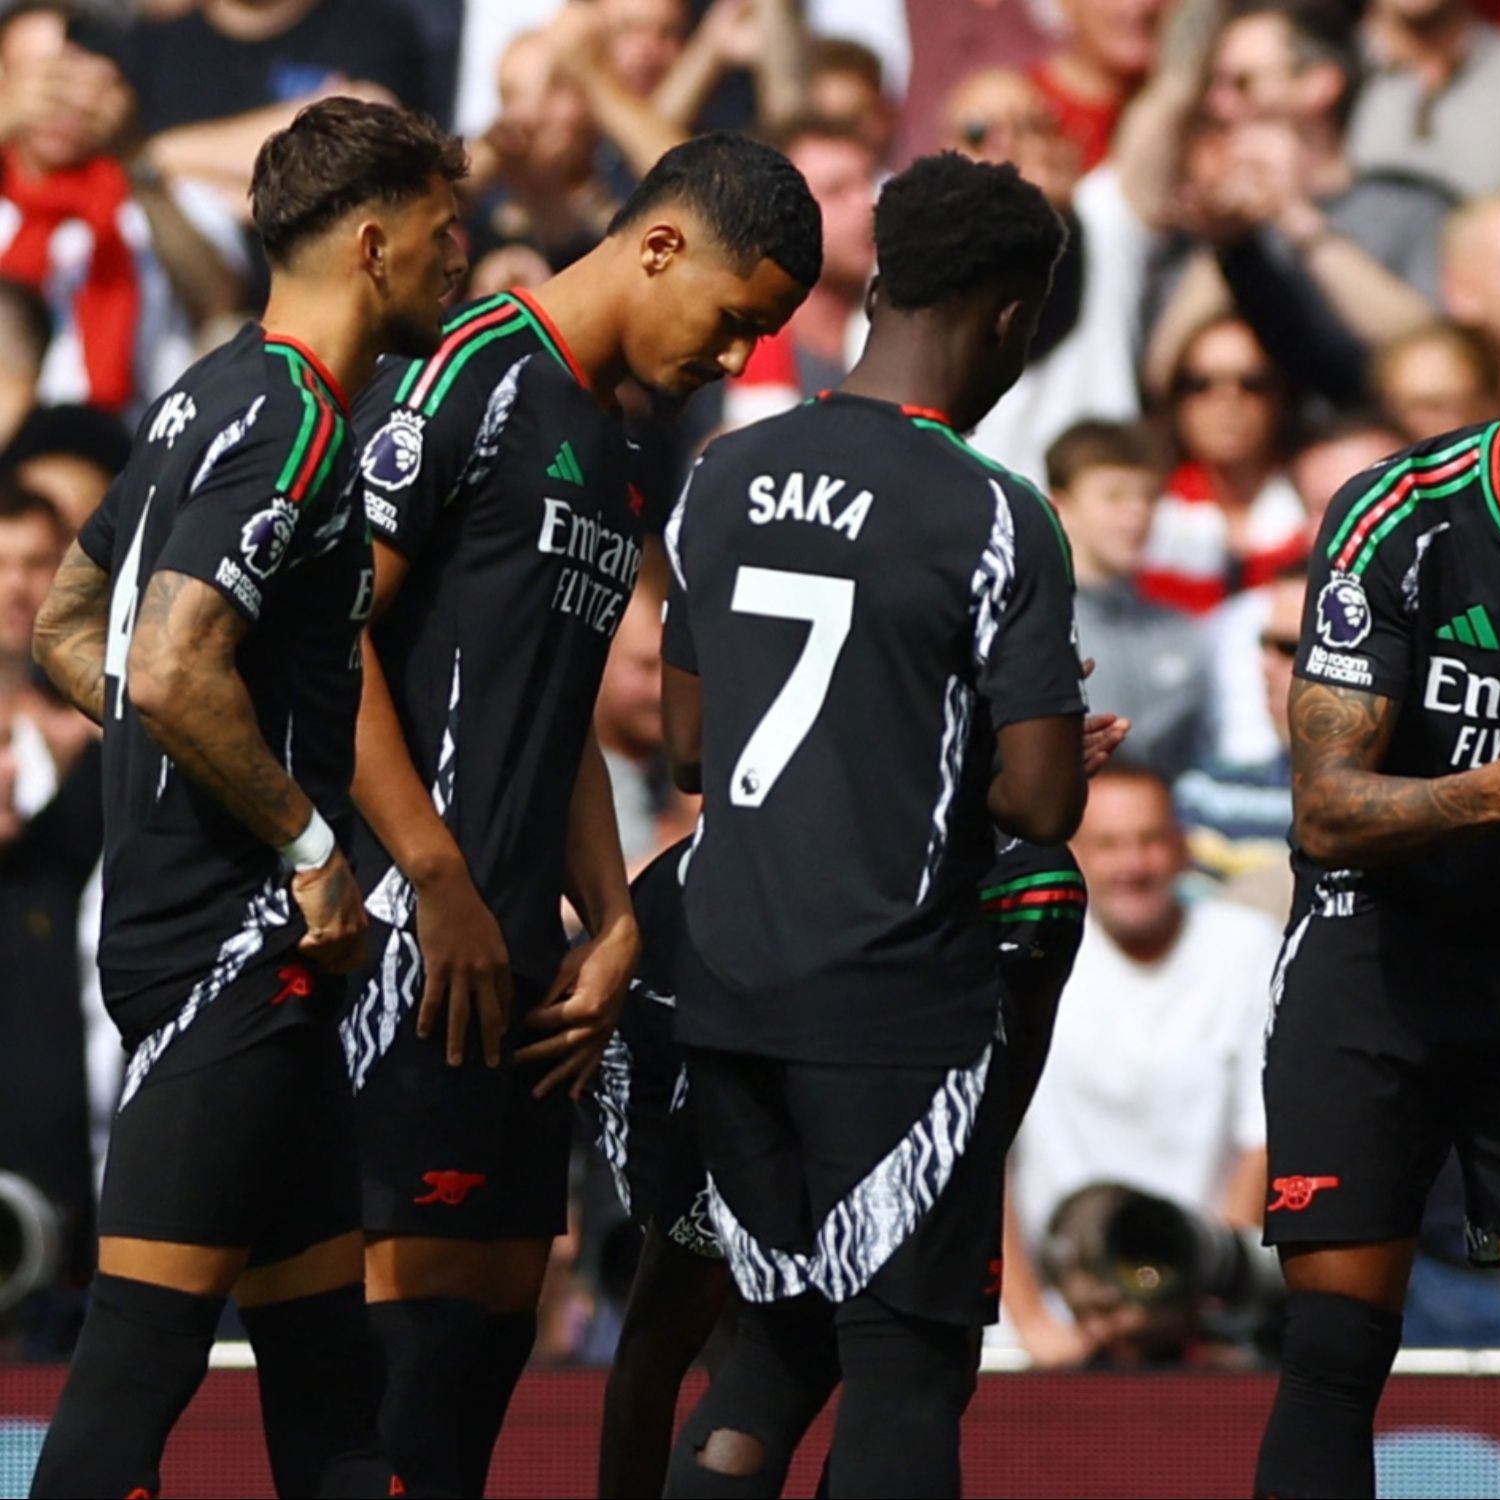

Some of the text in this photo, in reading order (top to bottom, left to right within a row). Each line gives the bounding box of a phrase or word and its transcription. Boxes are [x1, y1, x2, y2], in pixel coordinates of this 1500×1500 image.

[748, 472, 874, 541] SAKA
[104, 484, 156, 720] 4
[730, 565, 856, 808] 7
[1306, 644, 1369, 673] No room
[1323, 665, 1373, 687] racism
